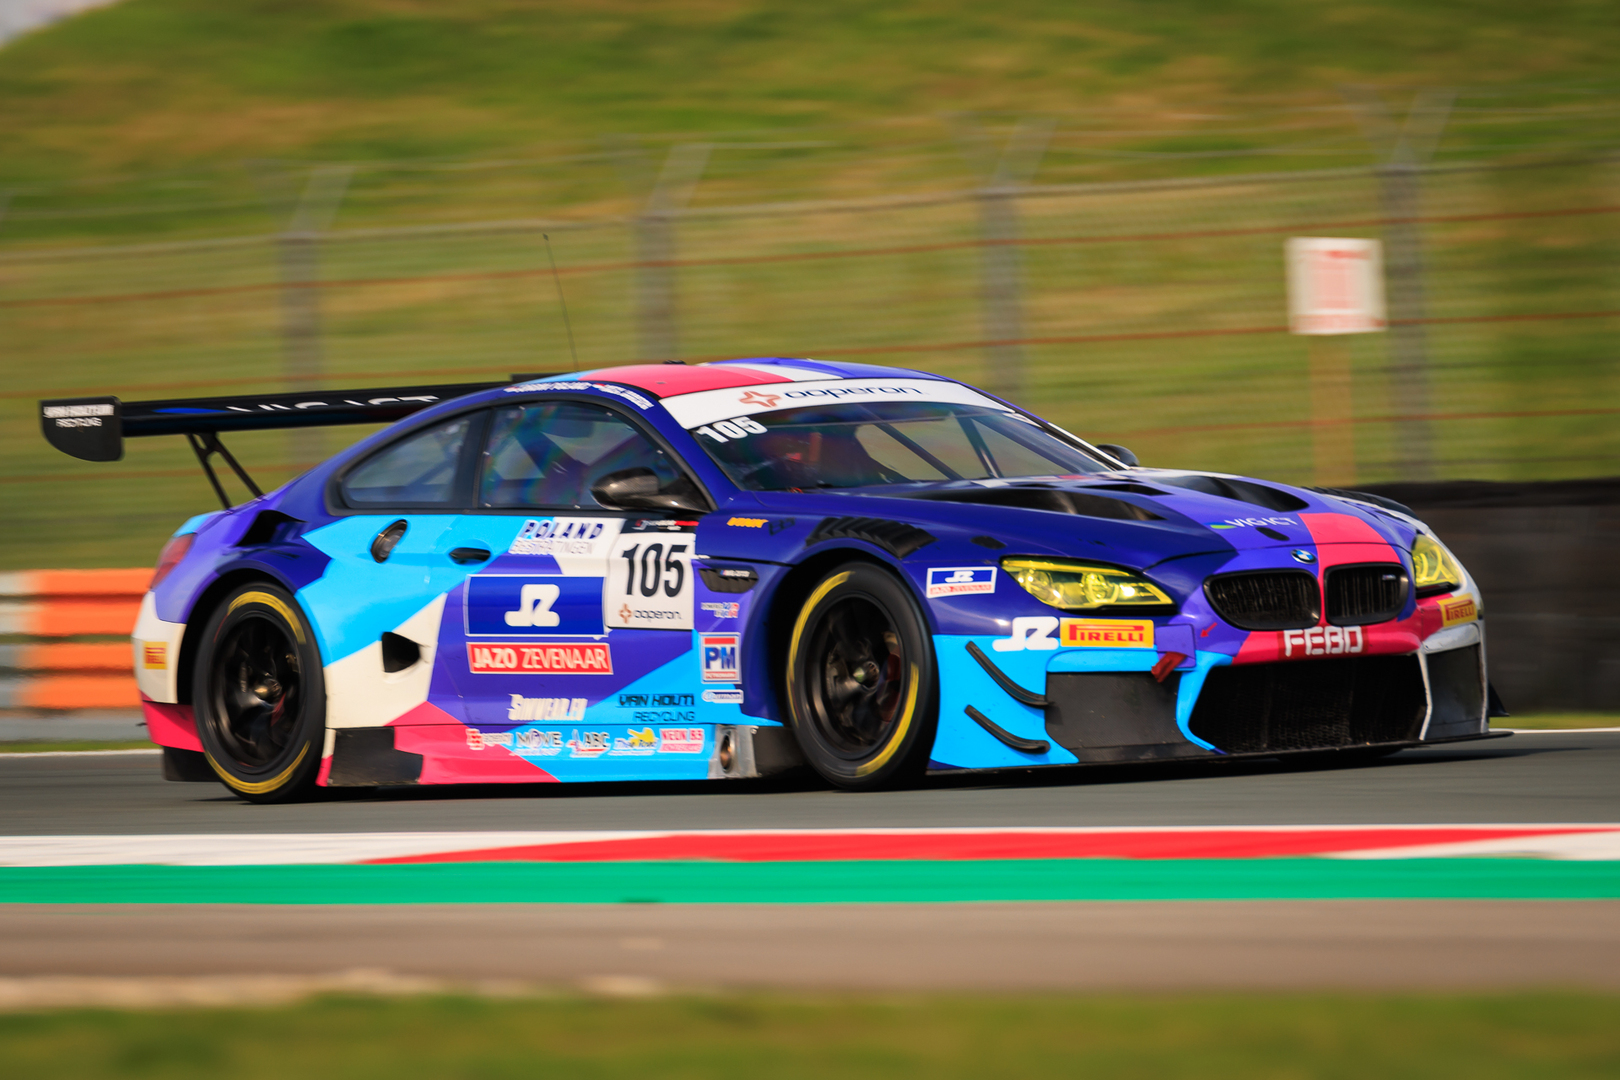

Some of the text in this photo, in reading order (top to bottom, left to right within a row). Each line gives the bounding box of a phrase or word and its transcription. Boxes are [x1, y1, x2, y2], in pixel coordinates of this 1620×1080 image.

[697, 416, 768, 443] 105
[519, 521, 604, 539] POLAND
[622, 543, 688, 597] 105
[1445, 599, 1475, 621] PIRELLI
[1069, 624, 1144, 642] PIRELLI
[1284, 626, 1364, 656] FEBO
[473, 648, 609, 669] JAZO ZEVENAAR
[705, 647, 736, 669] PM
[634, 711, 695, 722] RECYCLING
